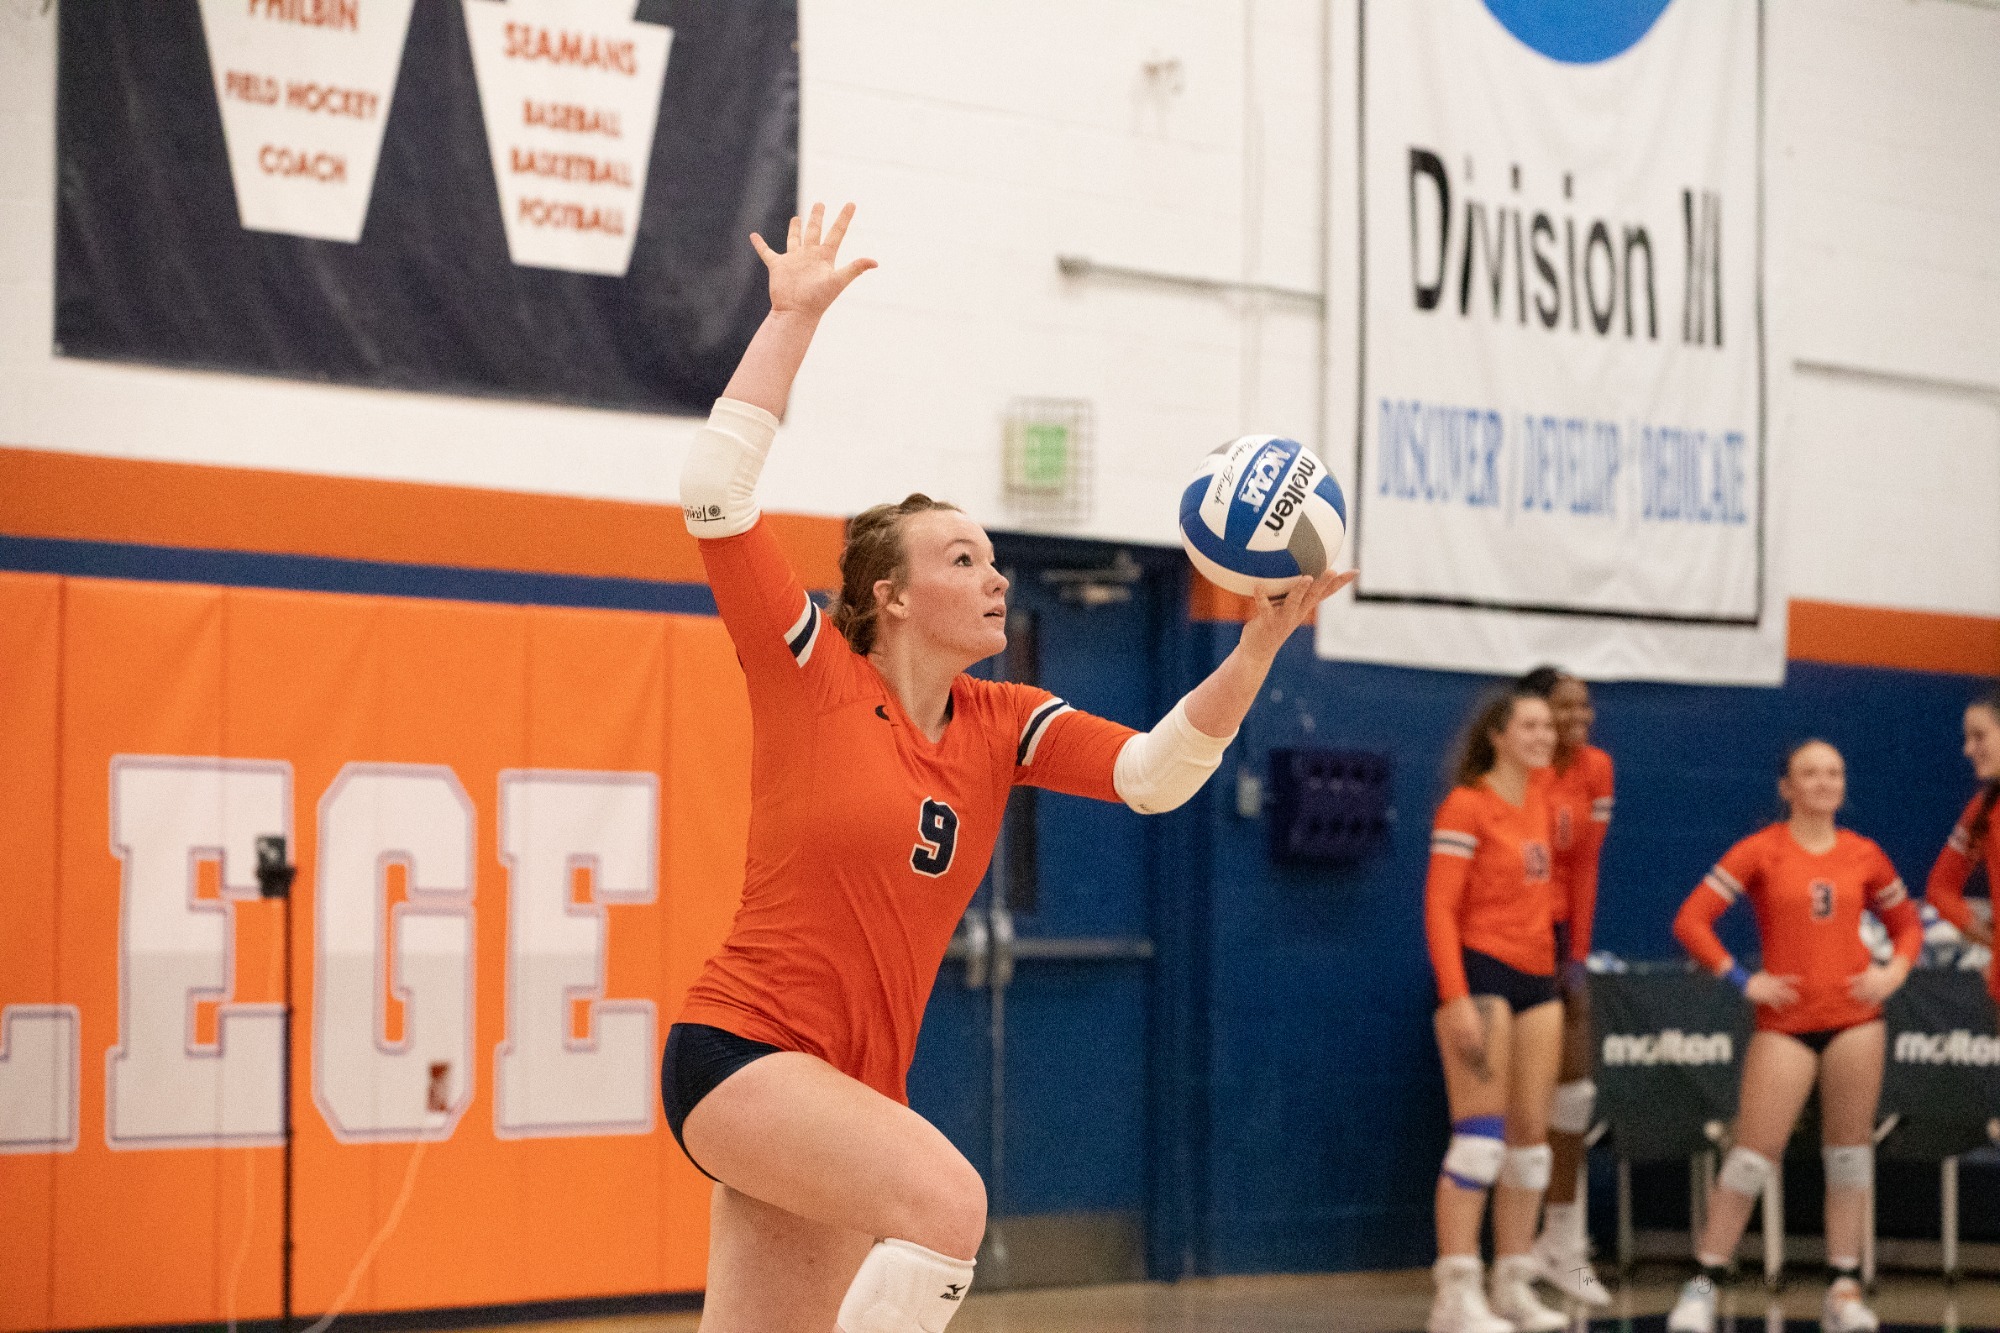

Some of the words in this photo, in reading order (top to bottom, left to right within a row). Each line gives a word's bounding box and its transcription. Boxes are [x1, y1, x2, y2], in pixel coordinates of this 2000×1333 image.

[503, 20, 637, 77] SEAMANS
[224, 69, 279, 106] FIELD
[285, 80, 379, 121] HOCKEY
[522, 98, 622, 139] BASEBALL
[257, 144, 348, 185] COACH
[509, 147, 633, 190] BASKETBALL
[518, 196, 625, 237] FOOTBALL
[1407, 145, 1657, 341] Division
[1680, 186, 1723, 349] III
[1239, 444, 1291, 507] NCAA
[1378, 397, 1502, 507] DISCOVER
[1522, 413, 1619, 520] DEVELOP
[1642, 424, 1746, 527] DEDICATE
[1264, 456, 1316, 532] molten
[909, 796, 960, 878] 9
[1810, 881, 1836, 918] 3
[1603, 1030, 1733, 1066] molten
